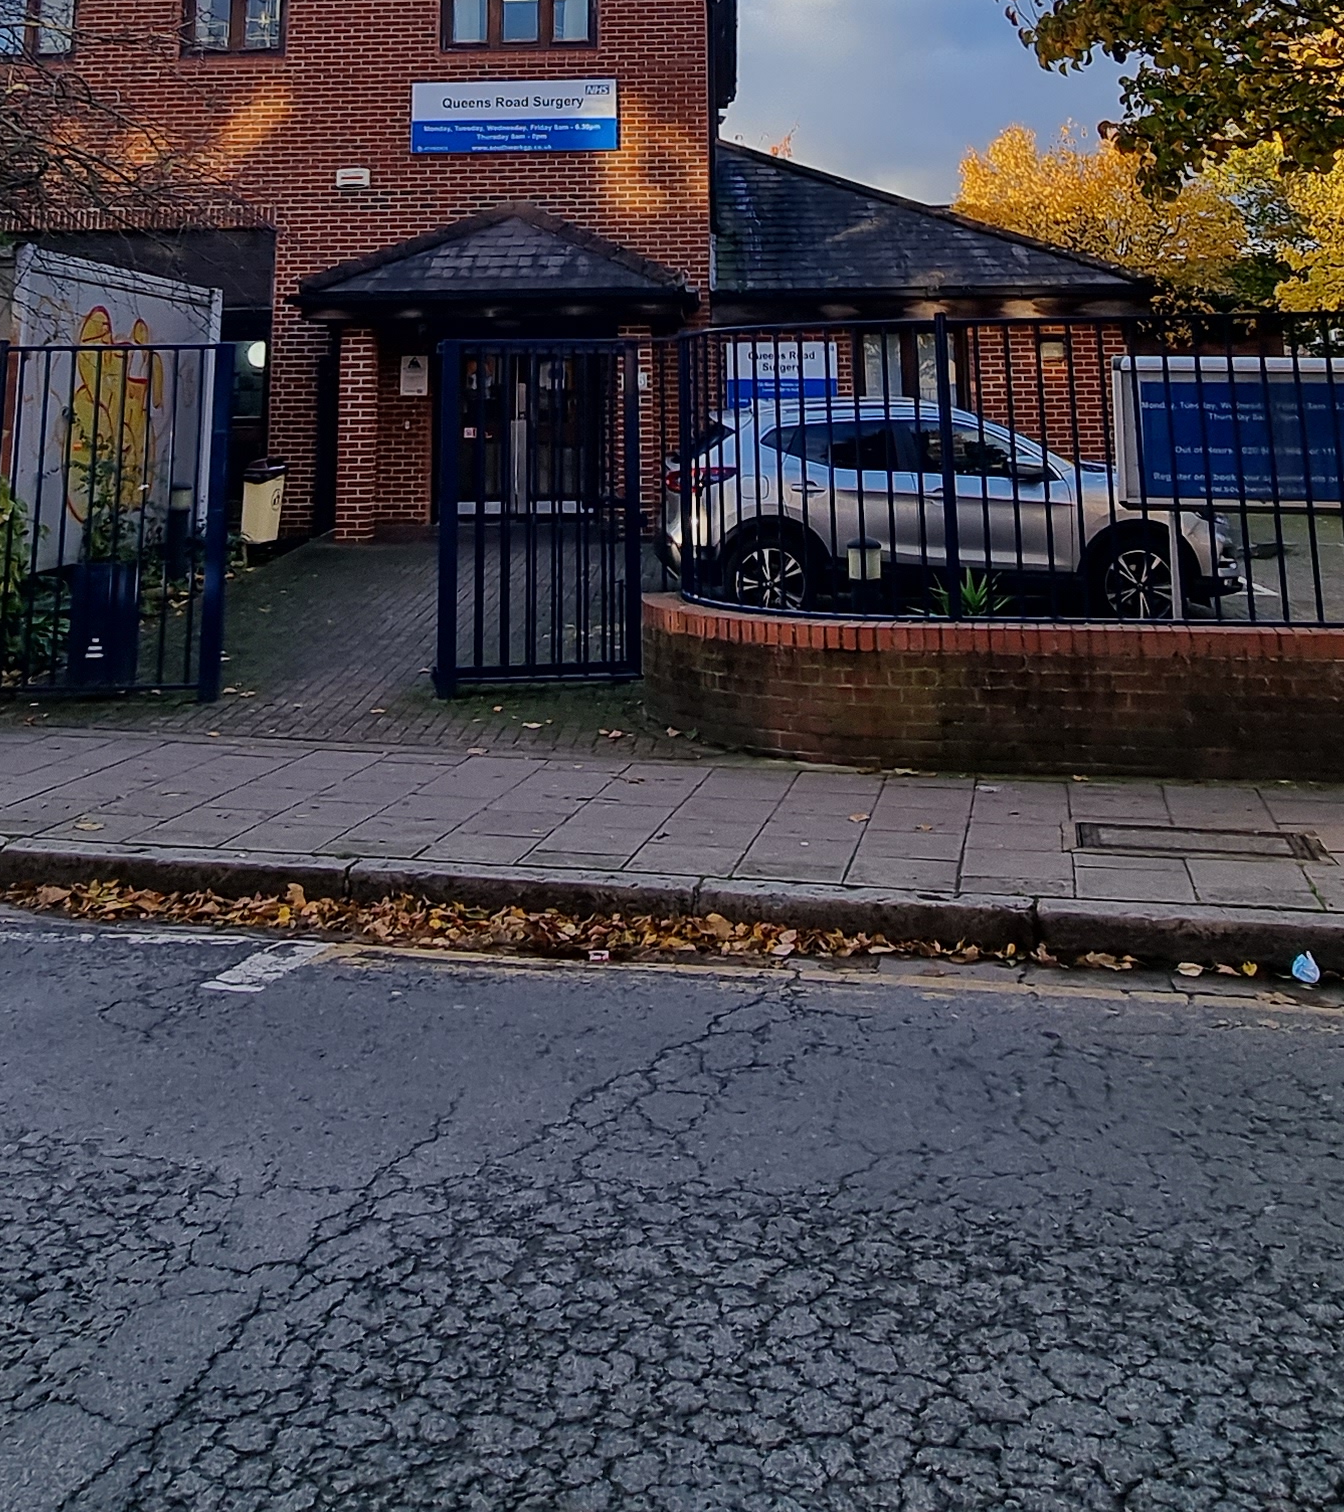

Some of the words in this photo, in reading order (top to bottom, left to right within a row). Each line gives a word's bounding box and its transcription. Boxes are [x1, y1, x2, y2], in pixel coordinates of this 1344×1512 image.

[586, 85, 609, 94] NHS
[442, 97, 491, 109] Queens
[495, 96, 529, 107] Road
[533, 96, 584, 109] Surgery
[530, 124, 552, 132] Friday
[476, 133, 509, 141] Thursday
